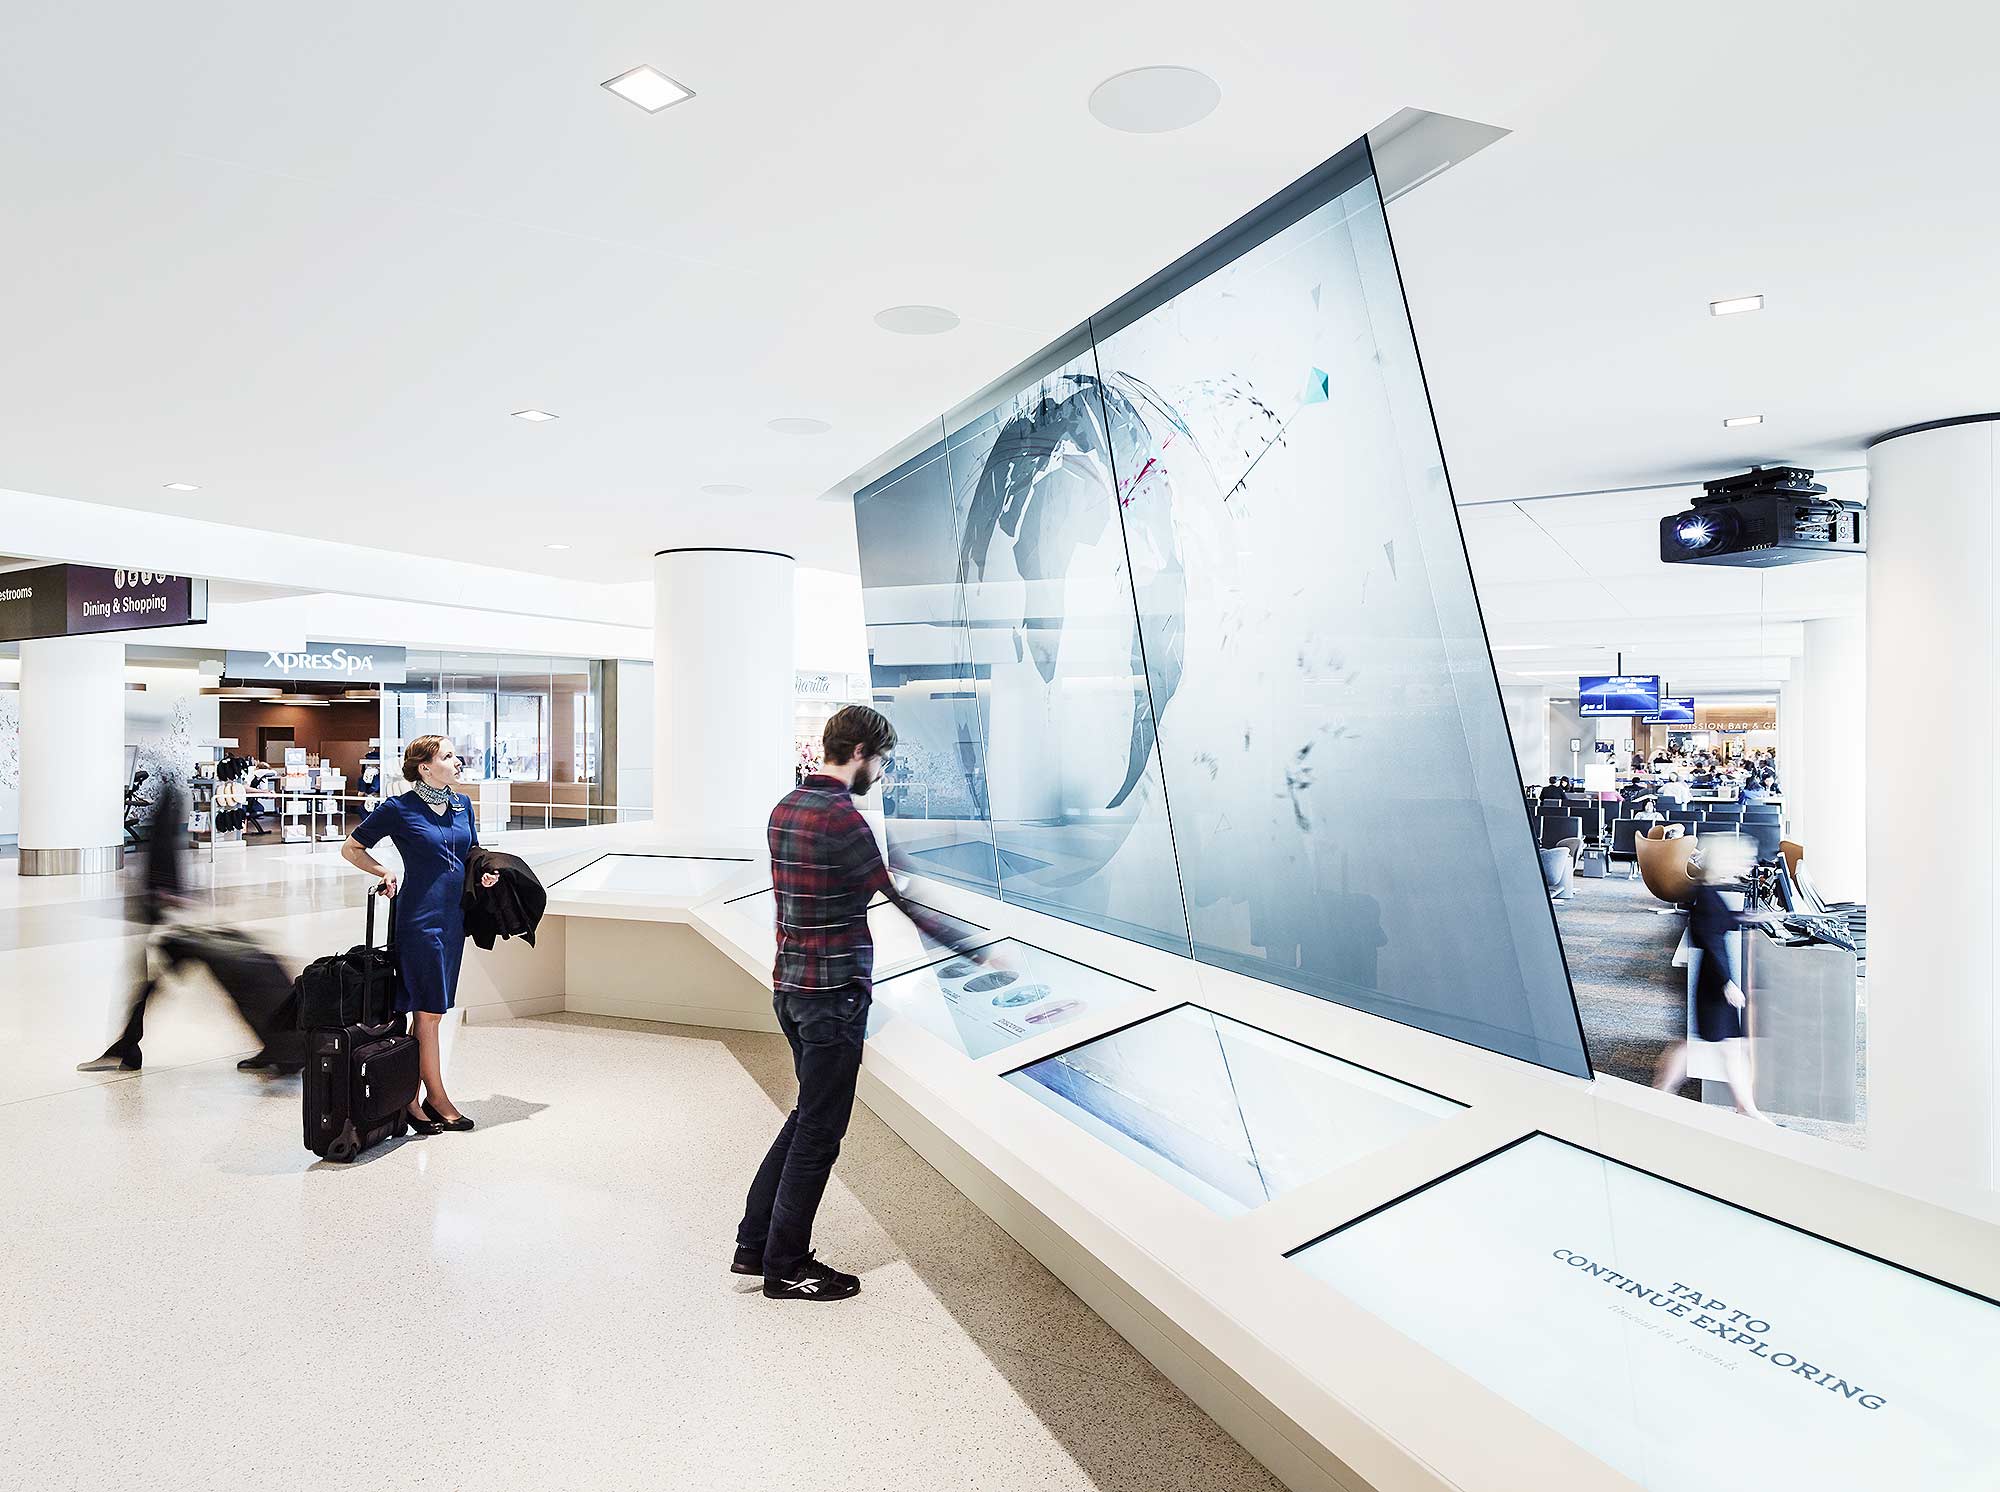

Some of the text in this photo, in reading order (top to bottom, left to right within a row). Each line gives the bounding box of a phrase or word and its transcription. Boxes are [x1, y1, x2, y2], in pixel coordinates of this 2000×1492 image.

[83, 594, 167, 618] Dining & Shopping
[1680, 722, 1723, 730] MISSION
[1728, 722, 1748, 730] BAR
[1752, 722, 1759, 730] &
[1667, 1282, 1771, 1333] TAP TO
[1552, 1249, 1887, 1410] CONTINUE EXPLORING
